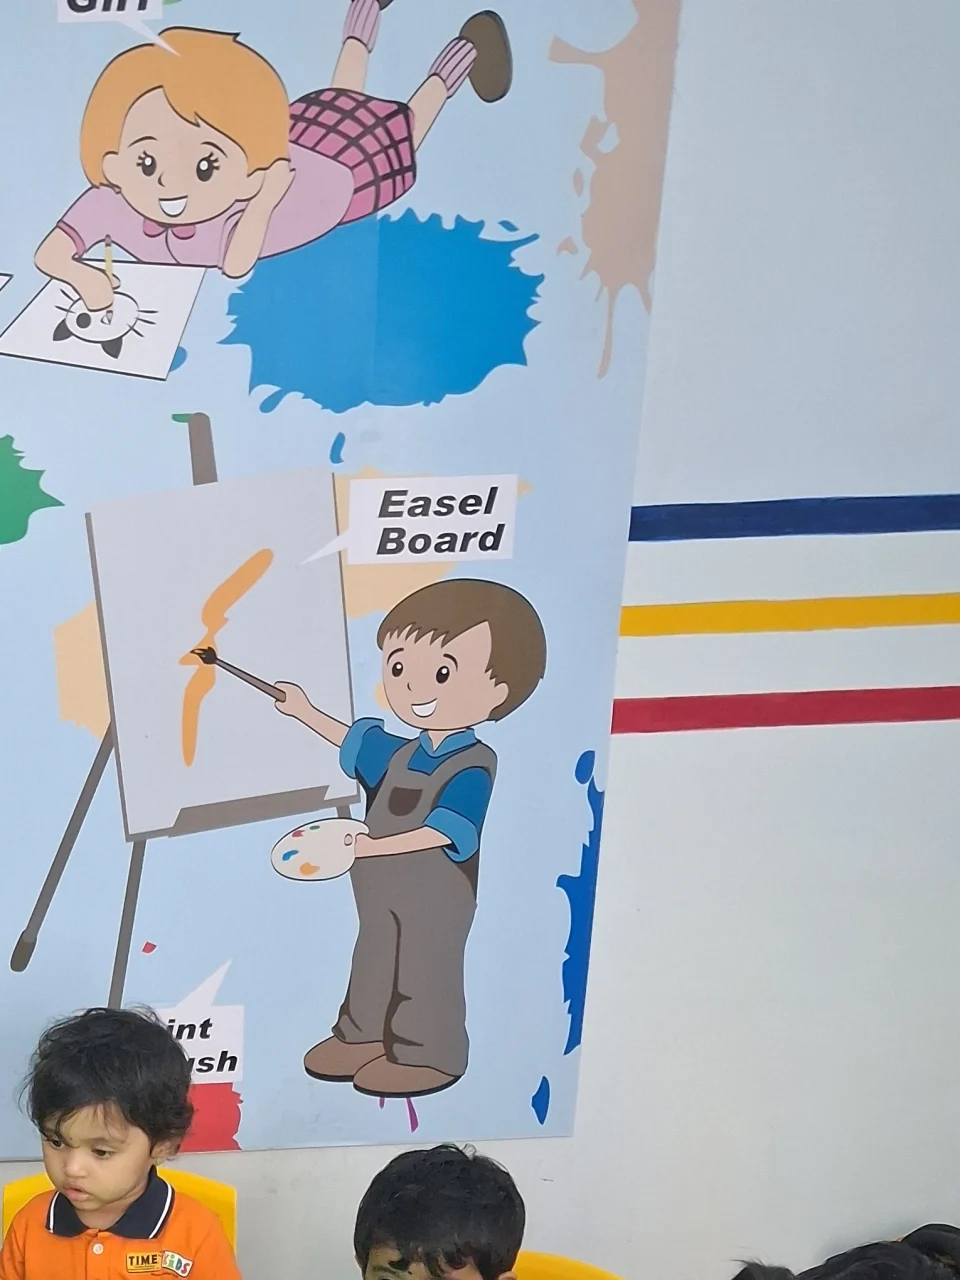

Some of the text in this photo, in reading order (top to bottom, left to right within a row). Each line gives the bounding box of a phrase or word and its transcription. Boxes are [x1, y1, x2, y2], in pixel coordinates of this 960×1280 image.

[378, 486, 499, 519] Easel
[377, 524, 506, 555] Board
[167, 1018, 213, 1040] int
[128, 1254, 158, 1267] TIME
